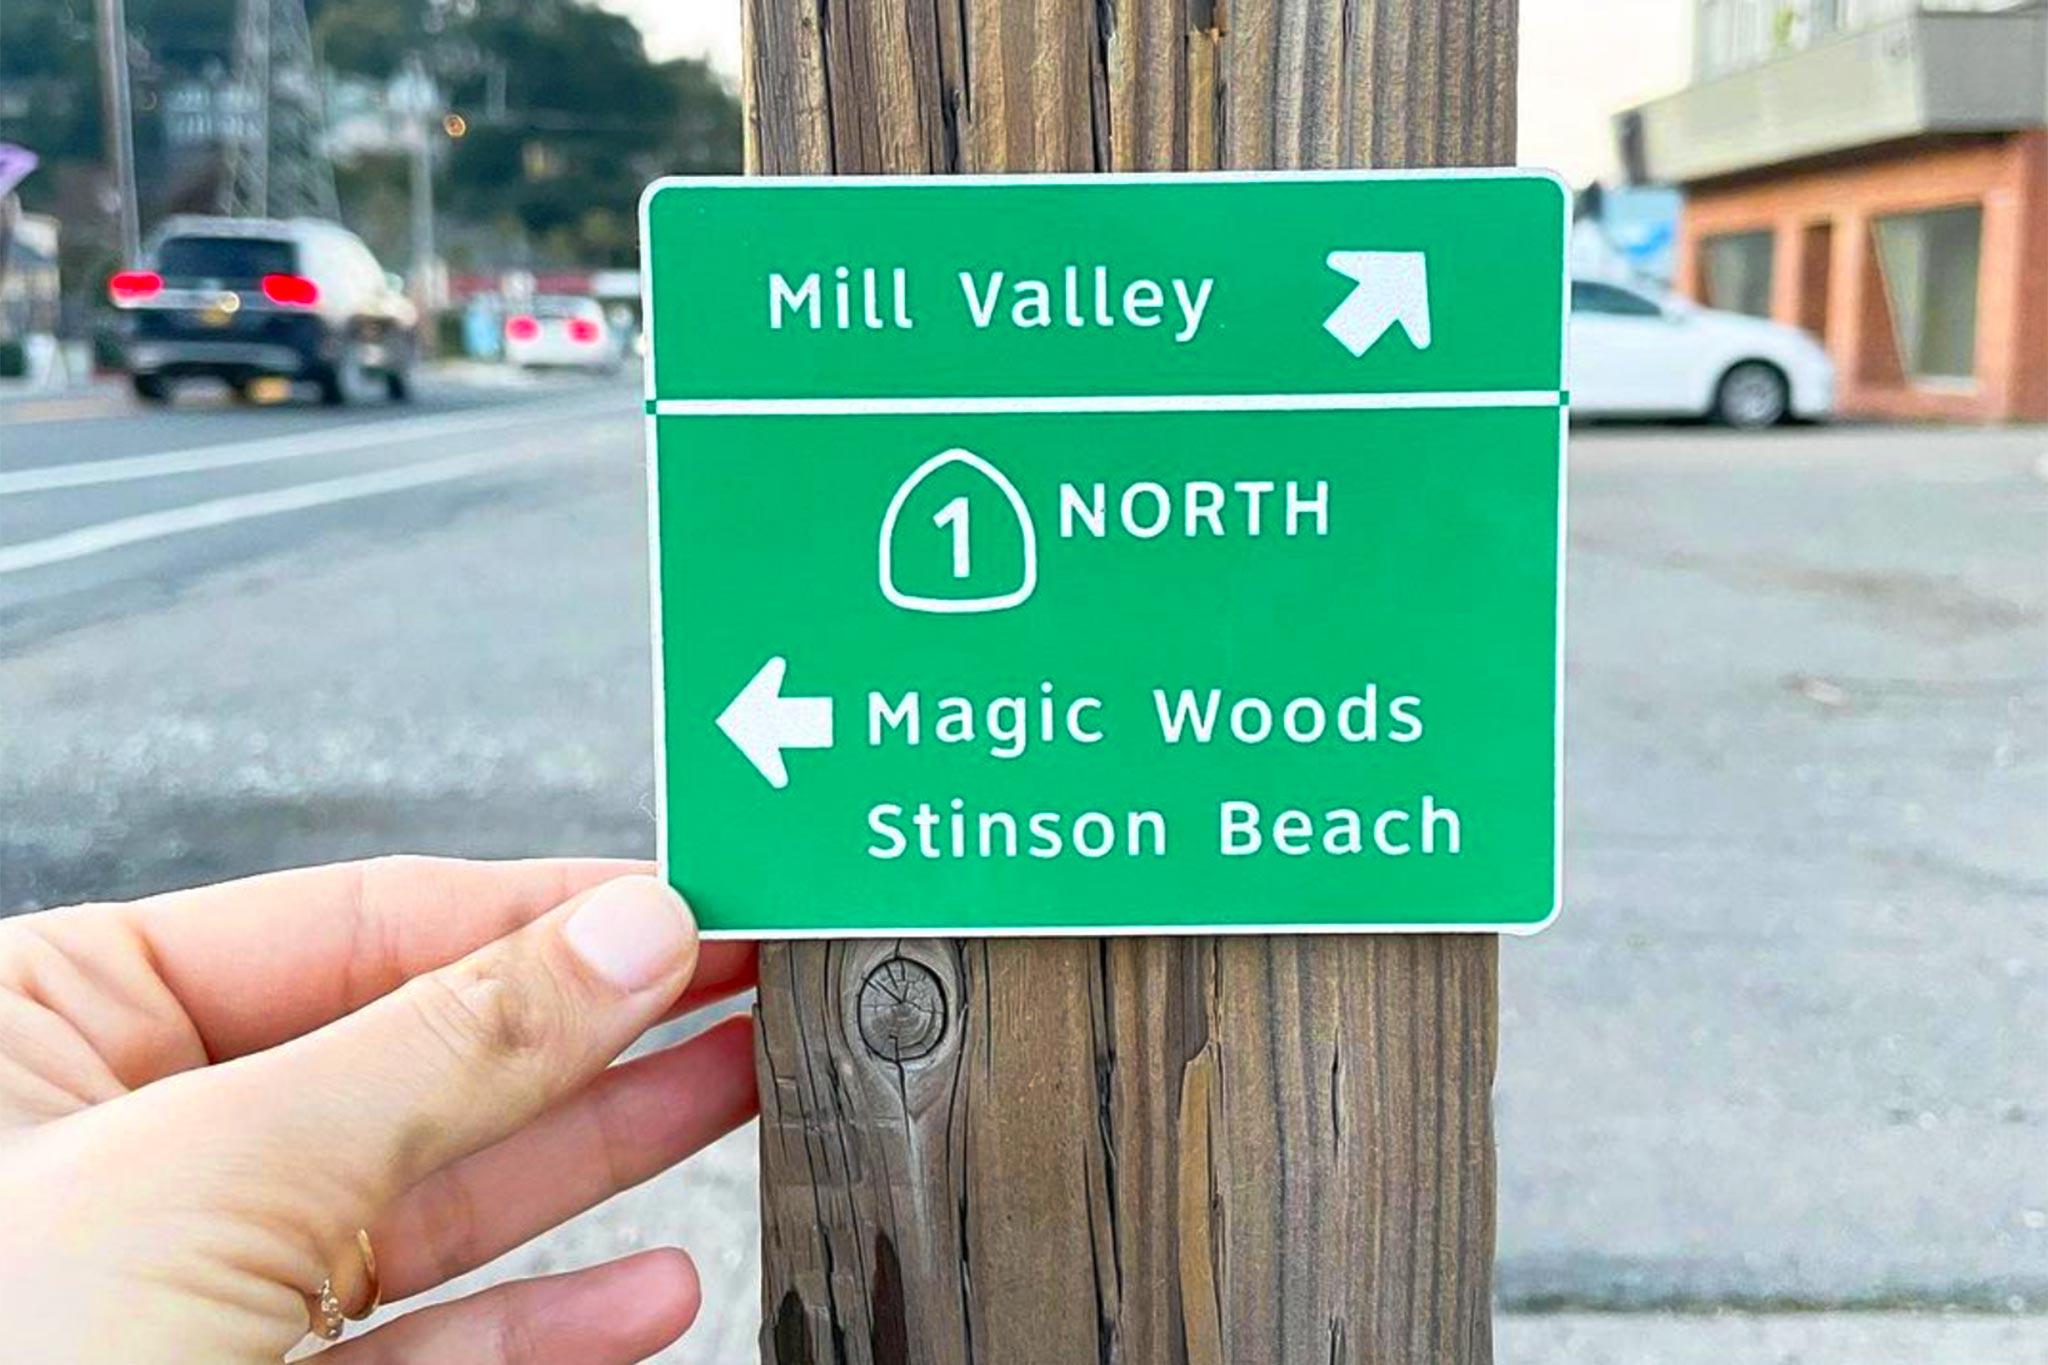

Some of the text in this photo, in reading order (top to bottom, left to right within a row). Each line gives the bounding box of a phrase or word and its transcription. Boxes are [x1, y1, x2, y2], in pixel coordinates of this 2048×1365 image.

[769, 267, 1215, 343] Mill Valley
[932, 480, 1329, 578] 1 NORTH
[868, 682, 1423, 759] Magic Woods
[867, 796, 1461, 860] Stinson Beach
